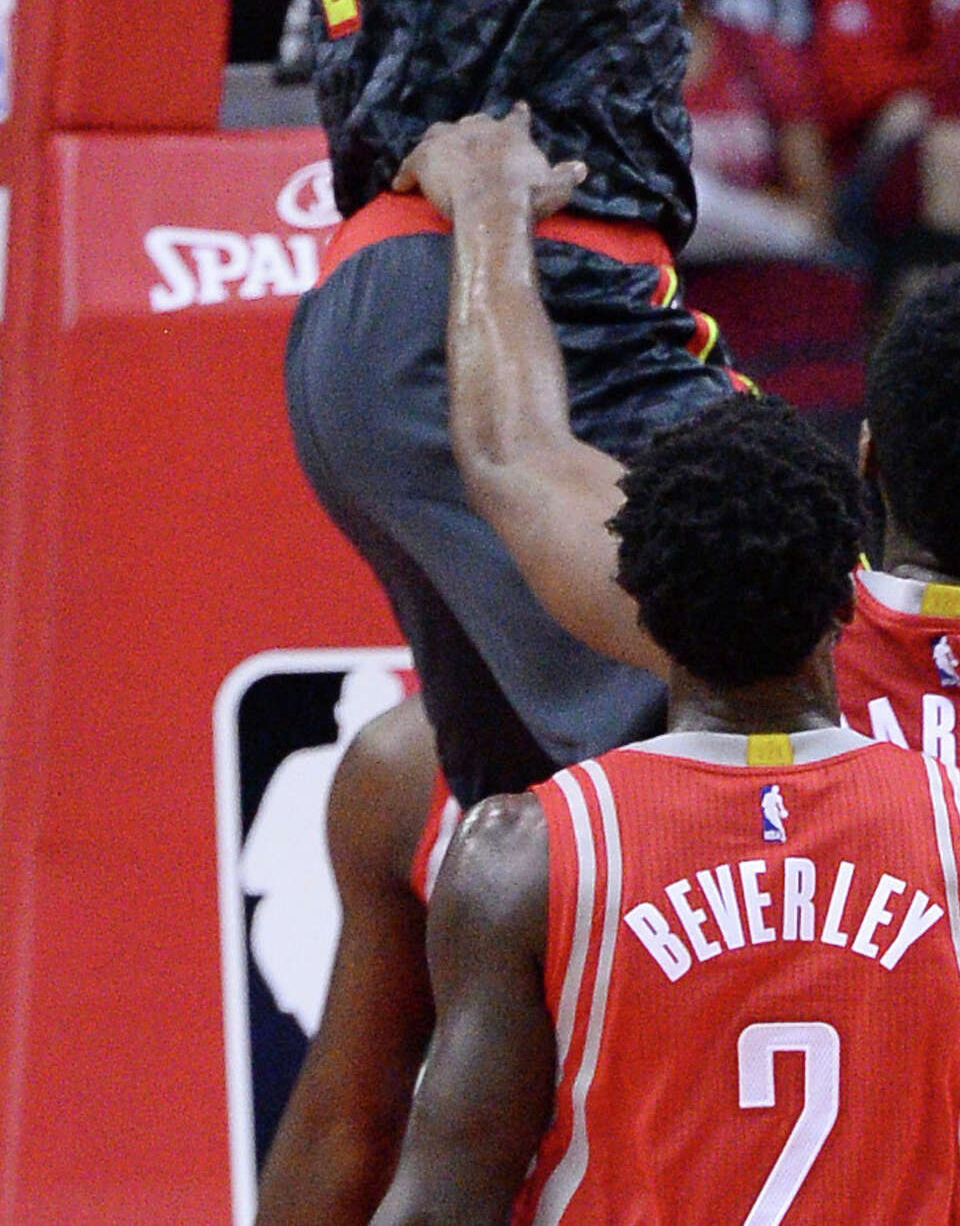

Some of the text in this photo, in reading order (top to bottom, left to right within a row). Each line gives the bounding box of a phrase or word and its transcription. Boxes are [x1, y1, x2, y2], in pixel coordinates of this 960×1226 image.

[143, 224, 321, 314] SPAL
[623, 856, 944, 982] BEVERLEY
[737, 1021, 840, 1226] 2
